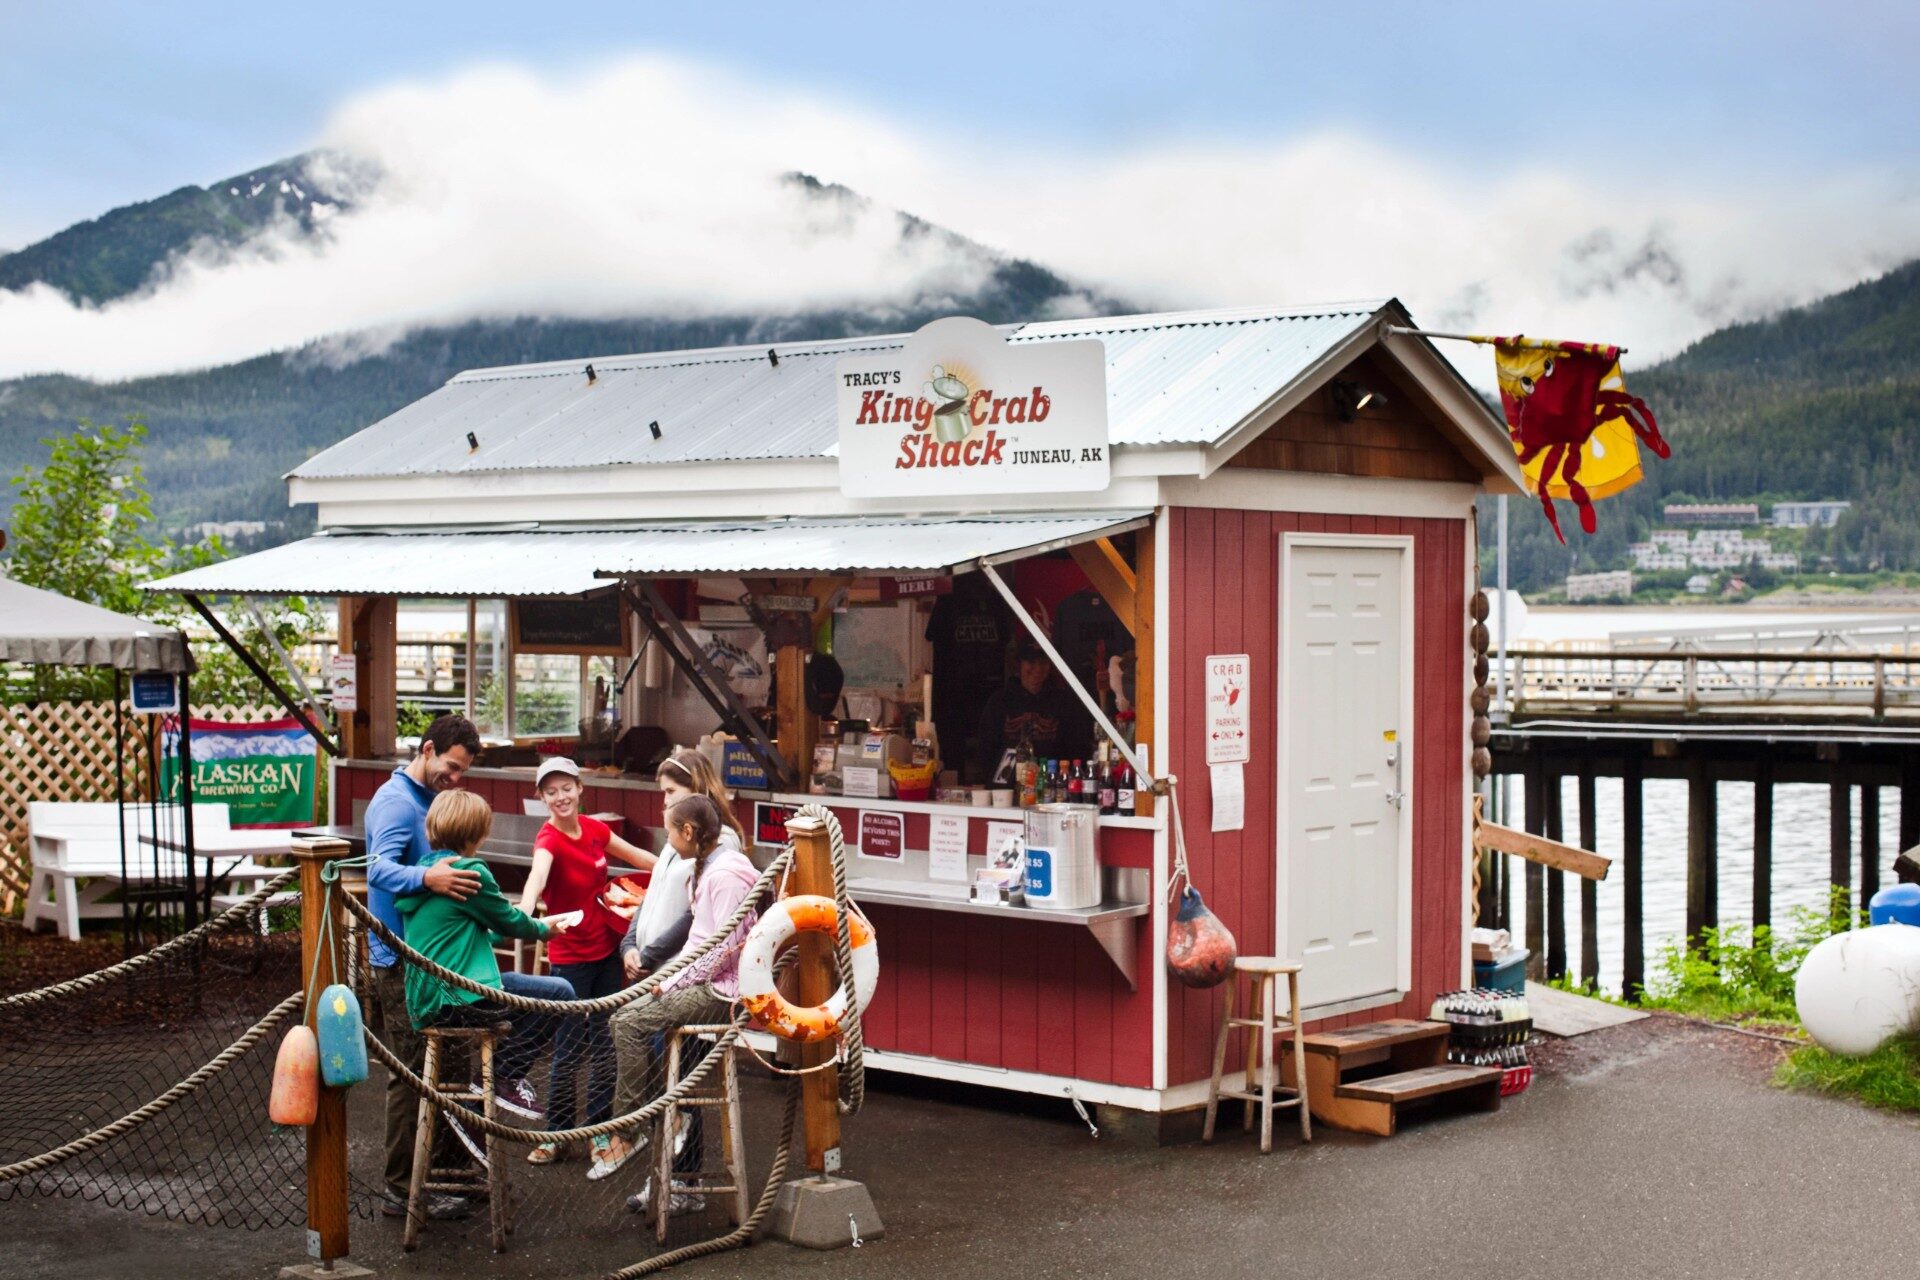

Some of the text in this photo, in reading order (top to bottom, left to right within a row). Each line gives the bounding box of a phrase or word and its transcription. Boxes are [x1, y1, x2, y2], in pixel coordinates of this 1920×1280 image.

[843, 370, 901, 387] TRACY'S
[855, 386, 1051, 431] King Crab
[895, 430, 1007, 470] Shack
[1012, 447, 1102, 465] JUNEAU, AK
[898, 579, 935, 594] HERE
[1213, 663, 1243, 676] CRAB
[1215, 716, 1241, 727] PARKING
[1220, 730, 1236, 741] ONLY
[200, 783, 280, 796] BREWING CO.
[863, 826, 887, 835] BEYOND
[1032, 858, 1043, 868] $5
[1032, 879, 1042, 889] $5
